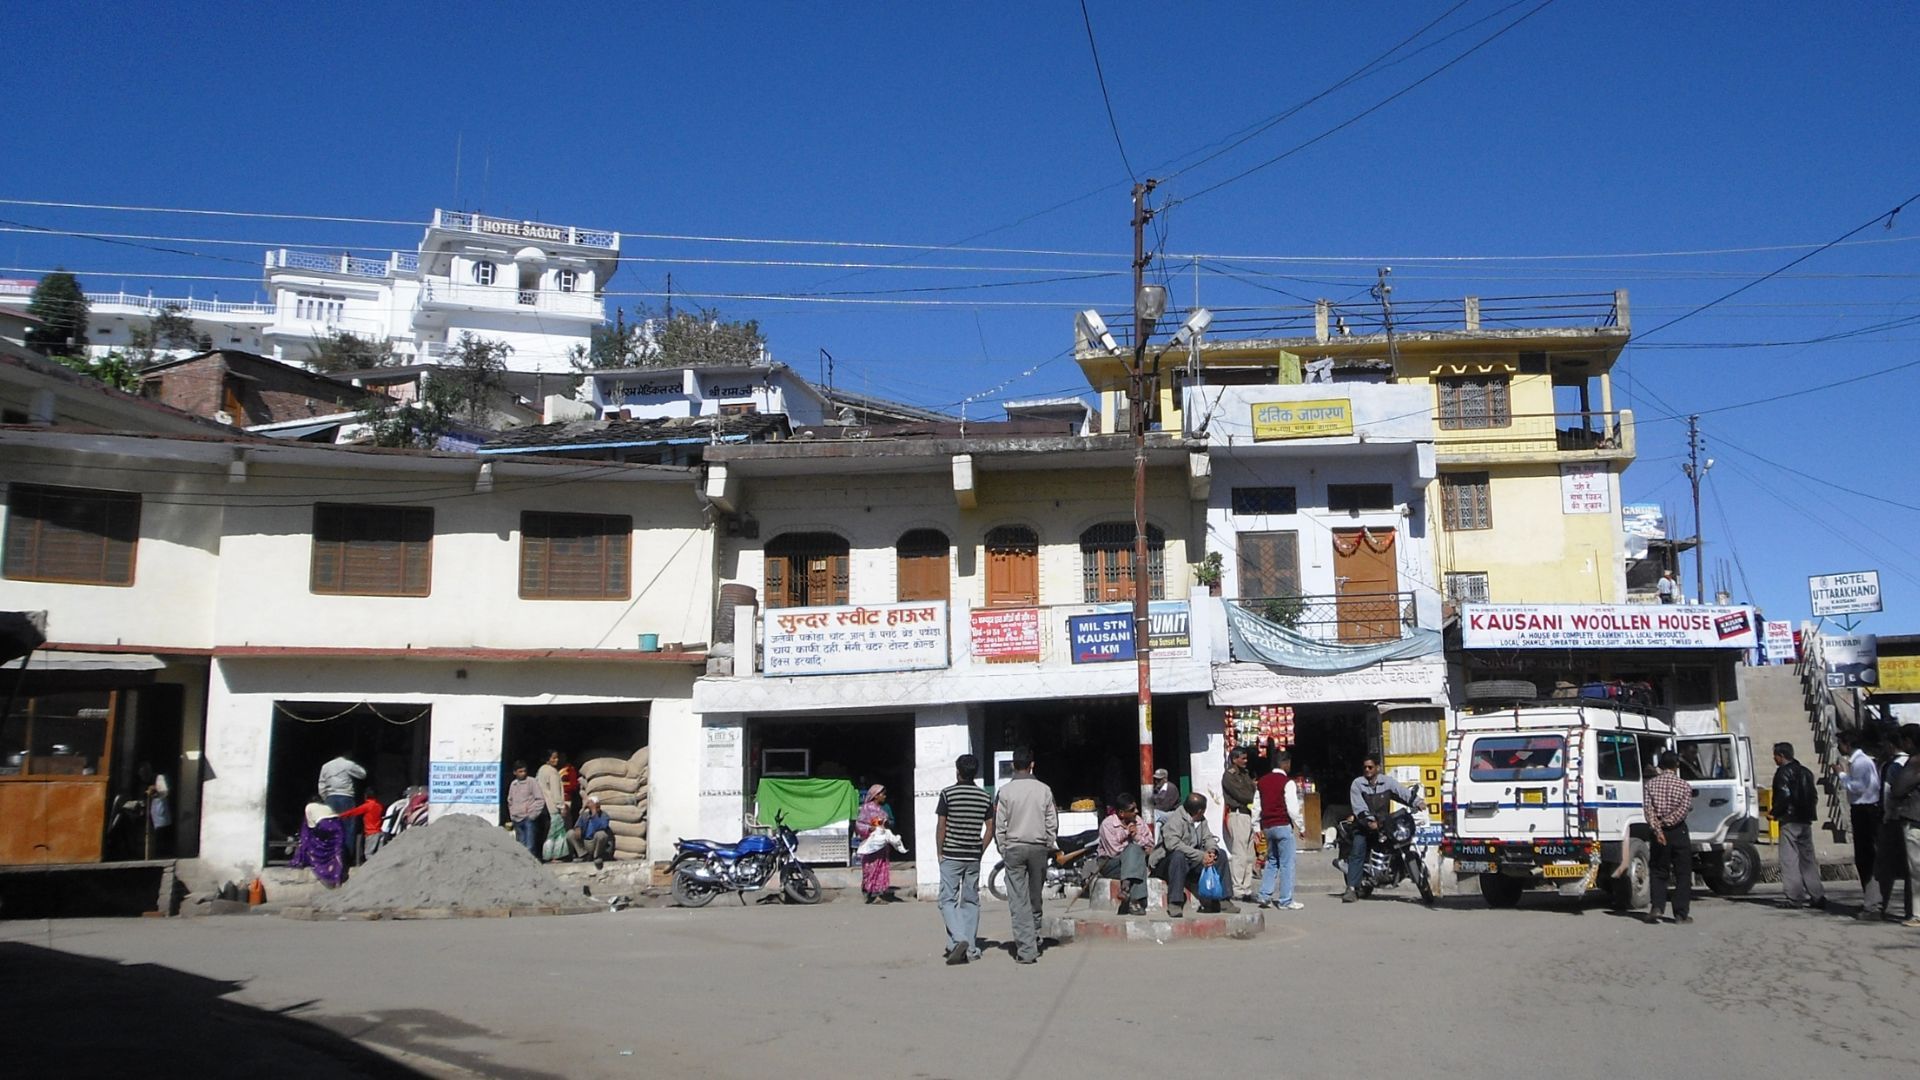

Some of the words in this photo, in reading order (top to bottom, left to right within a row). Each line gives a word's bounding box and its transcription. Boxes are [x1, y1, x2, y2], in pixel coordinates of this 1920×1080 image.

[482, 220, 520, 236] HOTEL
[522, 224, 560, 239] SAGAR
[668, 382, 684, 394] स्टो
[708, 385, 721, 396] श्री
[721, 387, 738, 396] राम
[1257, 406, 1293, 423] दैनिक
[1297, 407, 1344, 421] जागरण
[1834, 574, 1867, 585] HOTEL
[1813, 585, 1877, 600] UTTARAKHAND
[777, 613, 830, 633] सुन्दर
[836, 607, 881, 626] स्वीट
[887, 607, 936, 626] हाऊस
[1079, 622, 1101, 632] MIL
[1103, 620, 1127, 631] STN
[1469, 614, 1562, 630] KAUSANI
[1571, 614, 1650, 630] WOOLLEN
[1658, 614, 1711, 630] HOUSE
[1077, 632, 1130, 644] KAUSANI
[1529, 631, 1550, 639] HOUSE
[1562, 631, 1593, 639] COMPLETE
[1091, 646, 1097, 654] 1
[1101, 644, 1119, 654] KM
